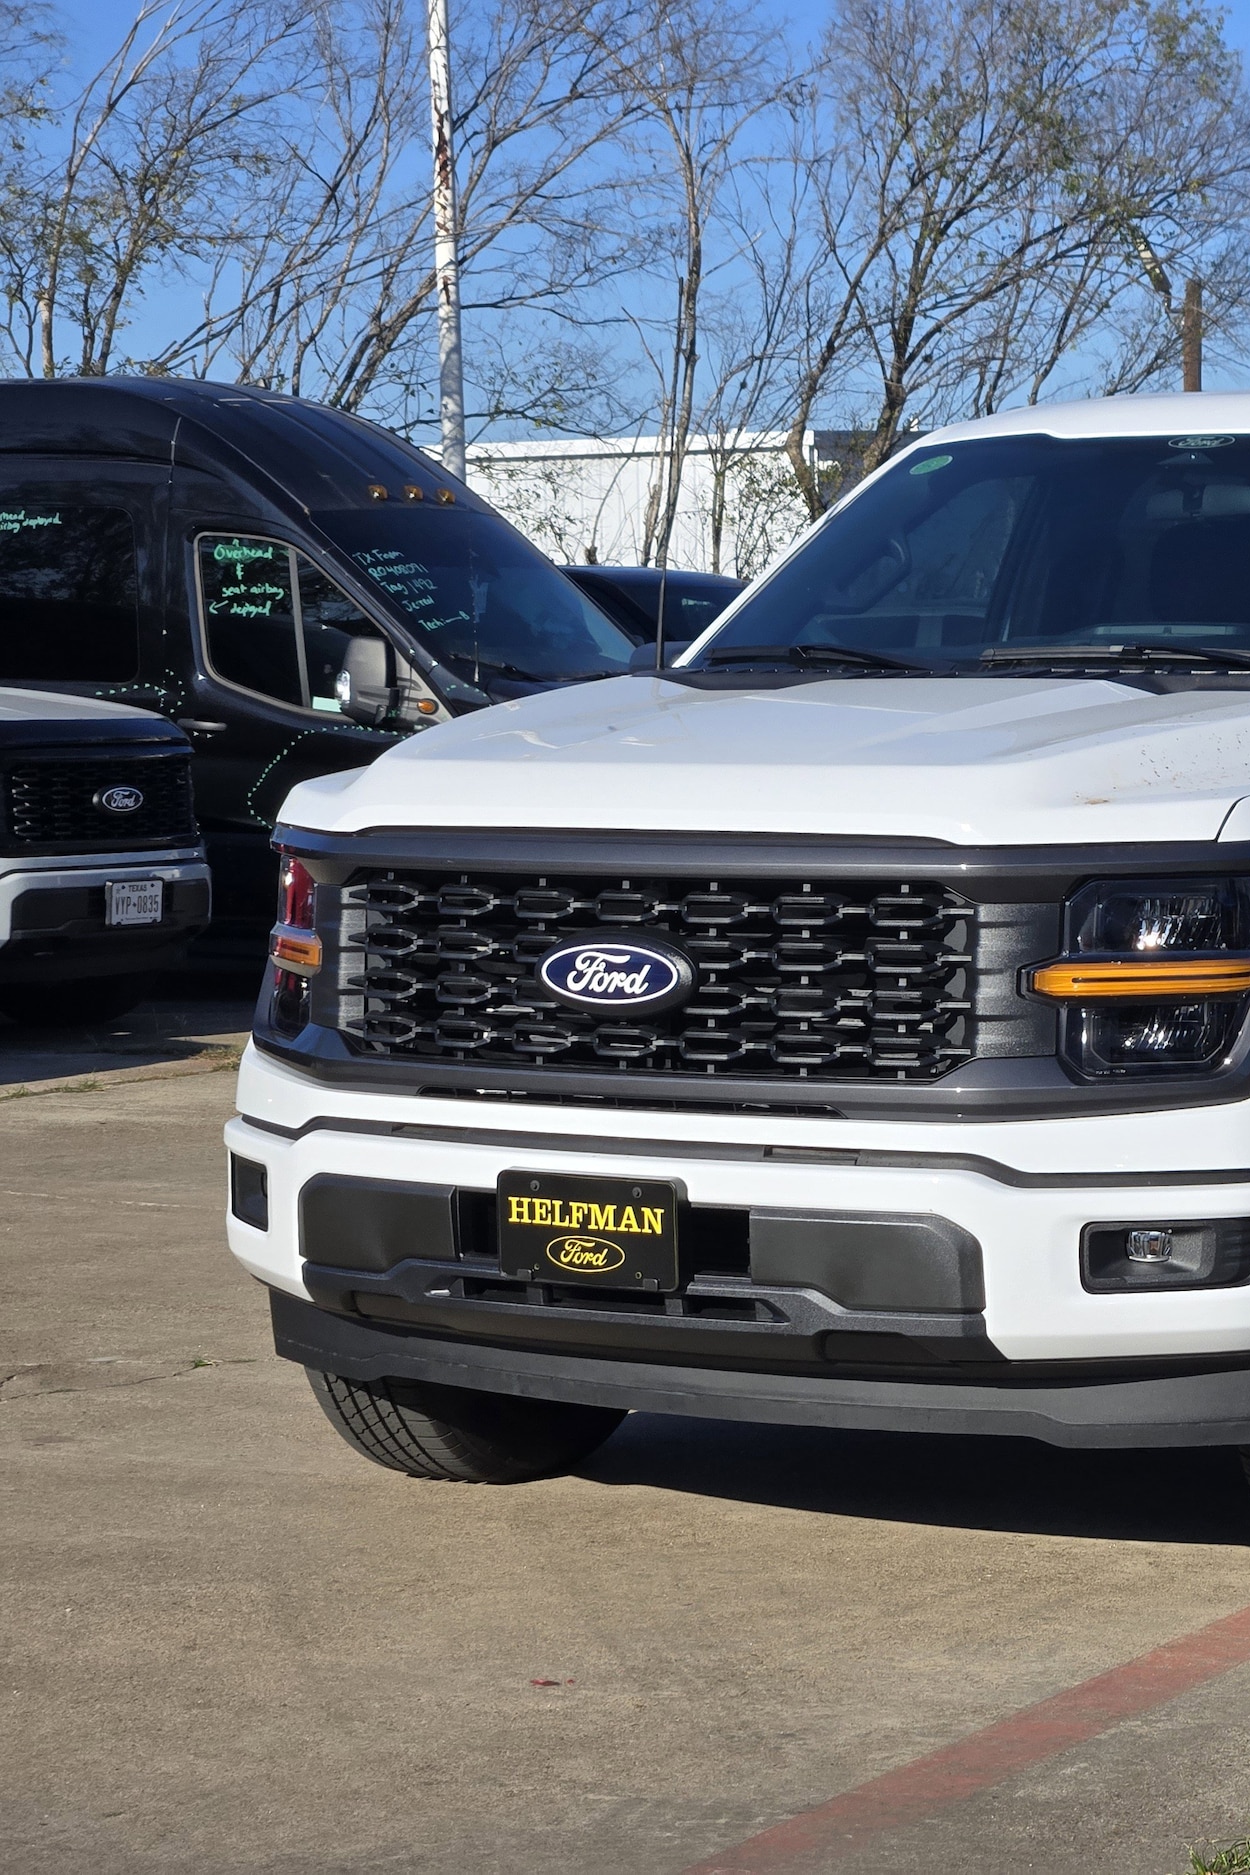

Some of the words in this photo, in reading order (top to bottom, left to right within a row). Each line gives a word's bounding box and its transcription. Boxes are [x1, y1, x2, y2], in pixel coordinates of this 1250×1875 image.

[1178, 435, 1225, 447] Ford
[214, 544, 274, 560] Overhead
[352, 551, 376, 566] TX
[222, 583, 247, 598] seat
[250, 582, 284, 600] airbag
[380, 581, 408, 595] Tag
[230, 600, 272, 618] deployed
[110, 790, 136, 807] Ford
[128, 884, 148, 892] TEXAS
[566, 951, 652, 995] Ford
[507, 1196, 665, 1235] HELFMAN
[560, 1239, 609, 1266] Ford
